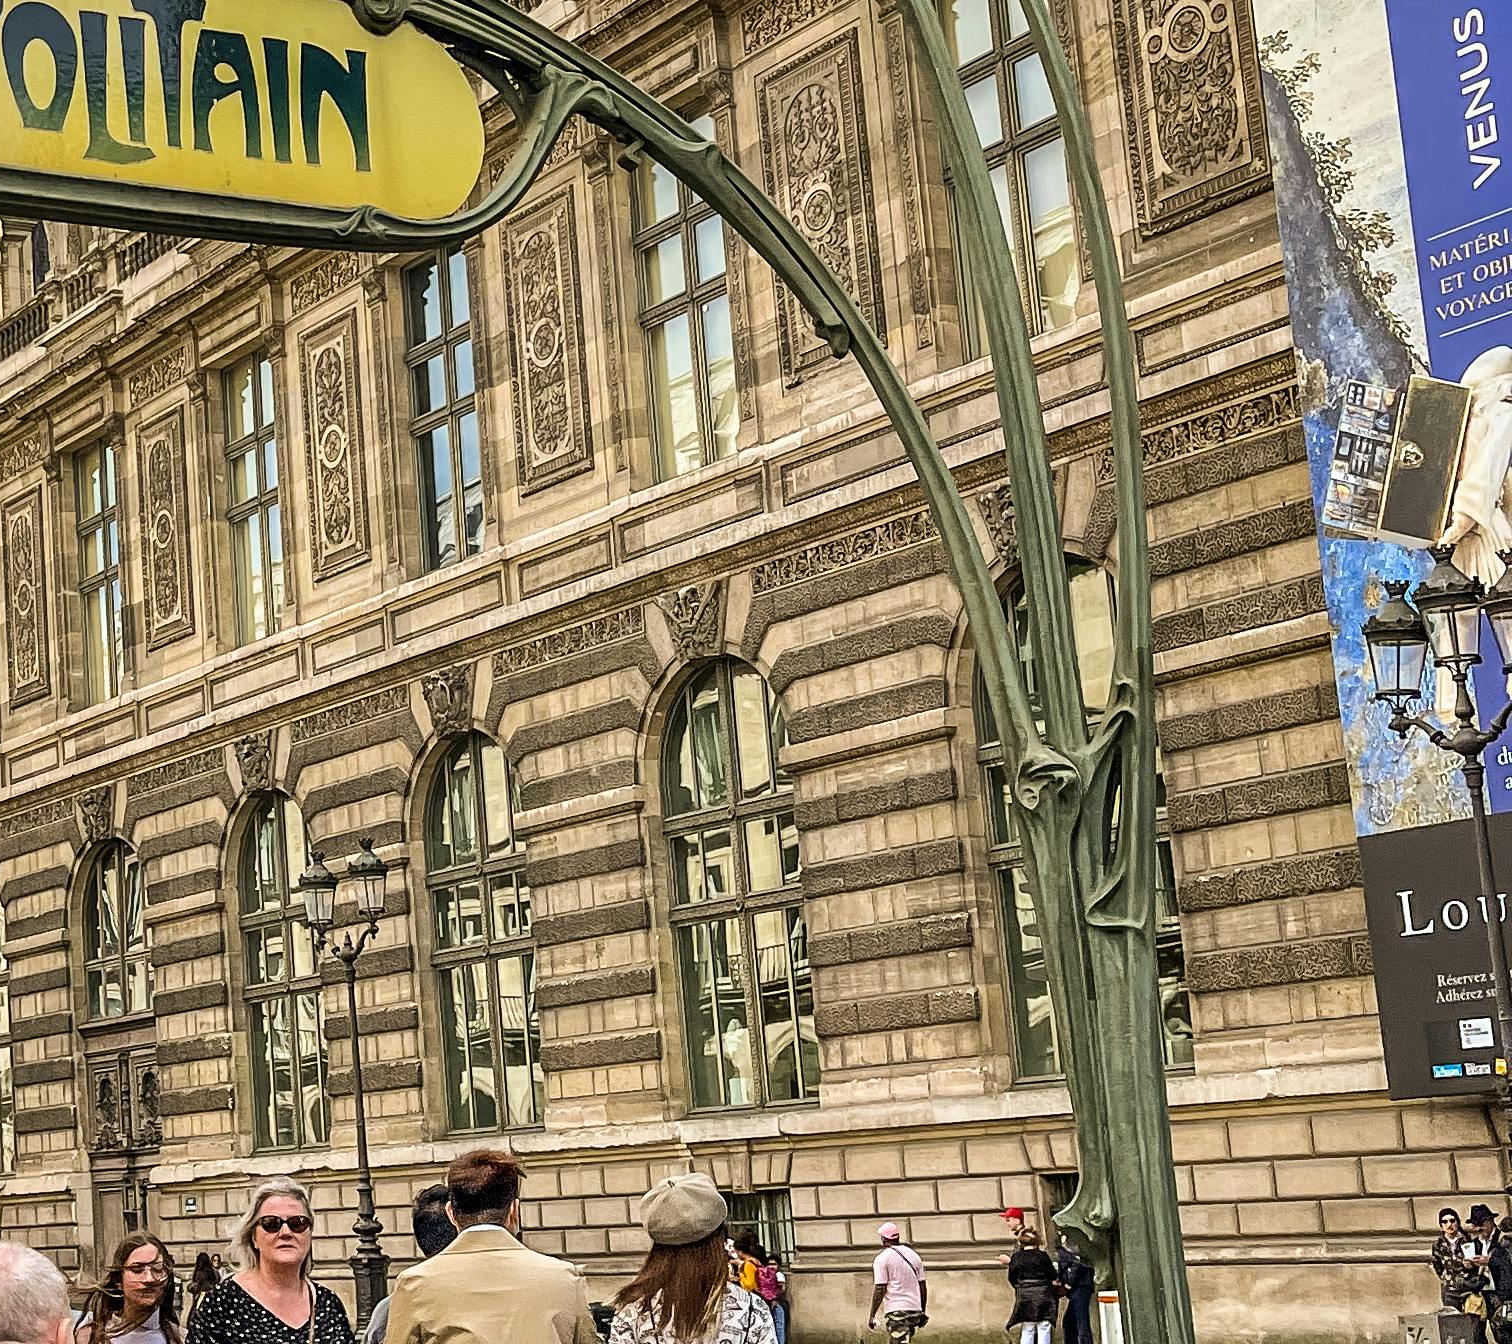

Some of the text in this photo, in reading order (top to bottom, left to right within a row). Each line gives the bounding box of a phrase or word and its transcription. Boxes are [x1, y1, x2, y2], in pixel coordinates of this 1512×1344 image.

[1452, 8, 1503, 190] VENUS
[1429, 228, 1512, 271] MATÉRI
[1440, 272, 1466, 295] ET
[1436, 973, 1488, 988] Réservez
[1435, 988, 1484, 1004] Adhérez
